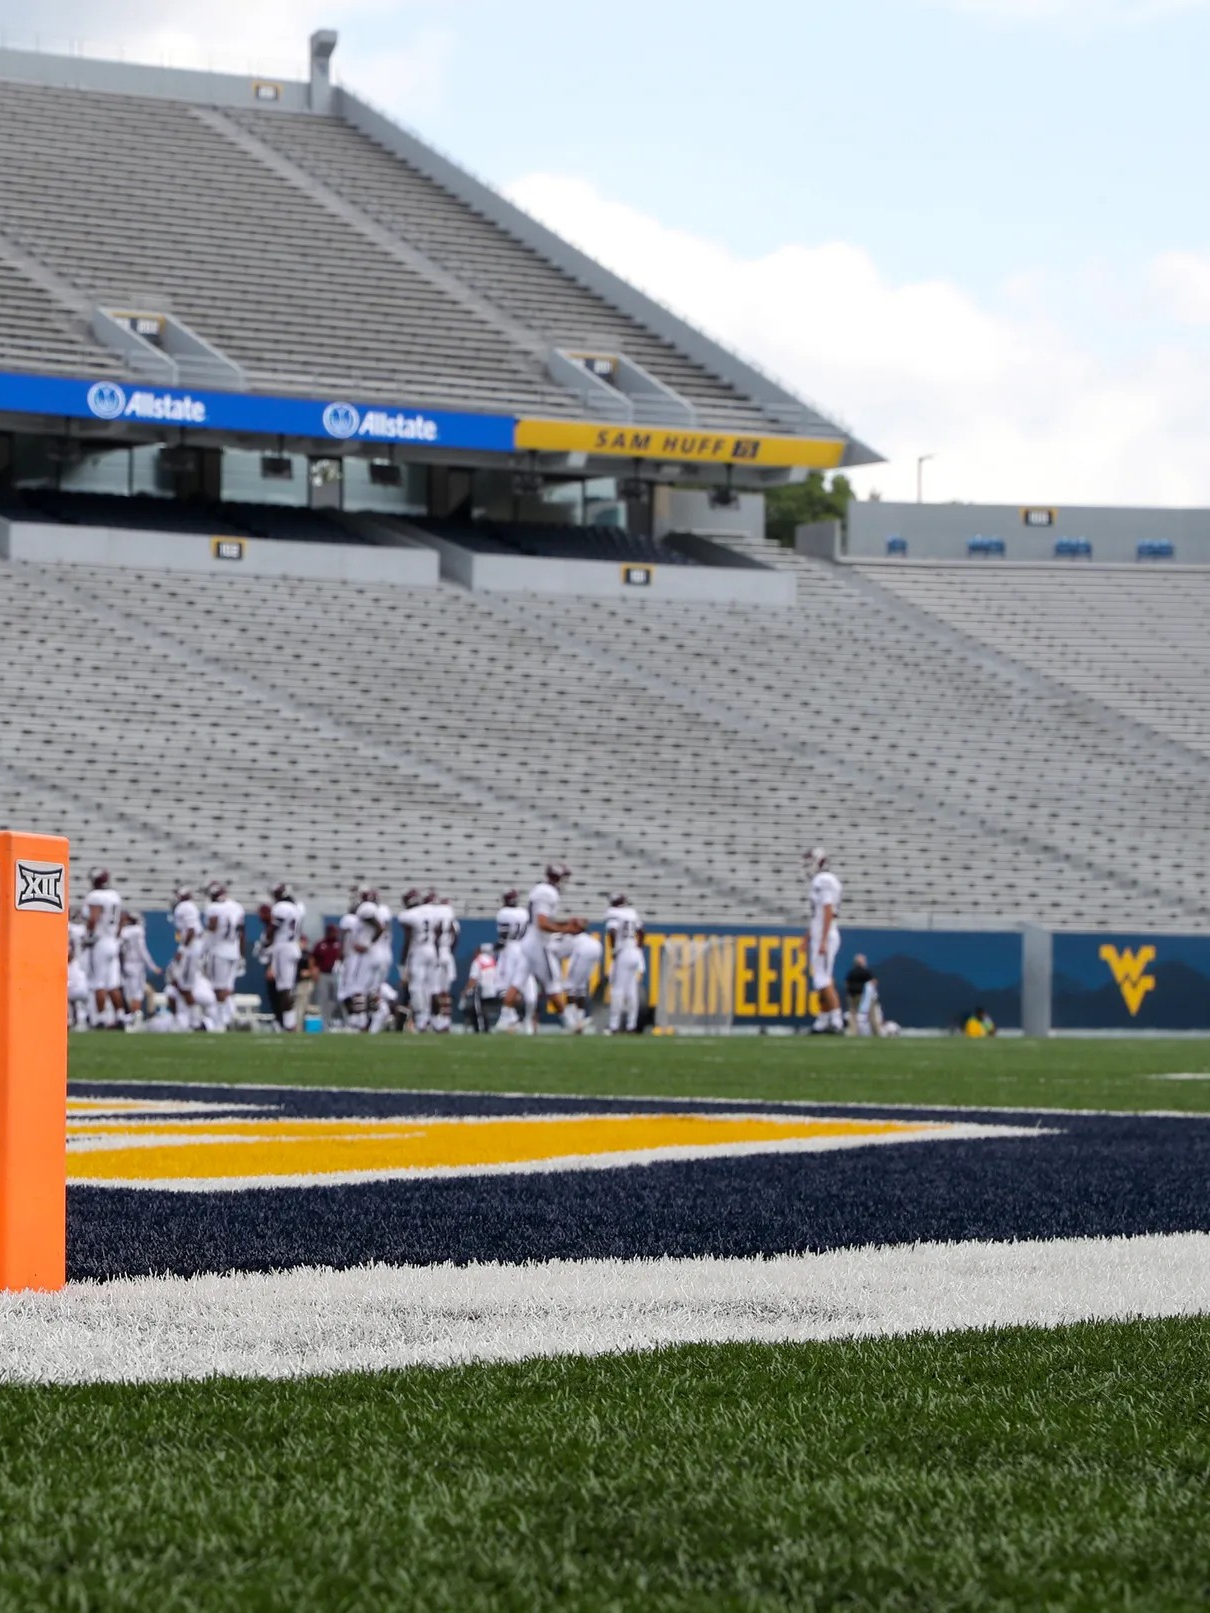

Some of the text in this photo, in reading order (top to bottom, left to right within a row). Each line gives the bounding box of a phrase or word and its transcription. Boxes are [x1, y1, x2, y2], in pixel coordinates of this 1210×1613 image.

[123, 391, 205, 422] Allstate
[357, 411, 437, 441] Allstate
[595, 430, 651, 450] SAM
[662, 434, 726, 456] HUFF
